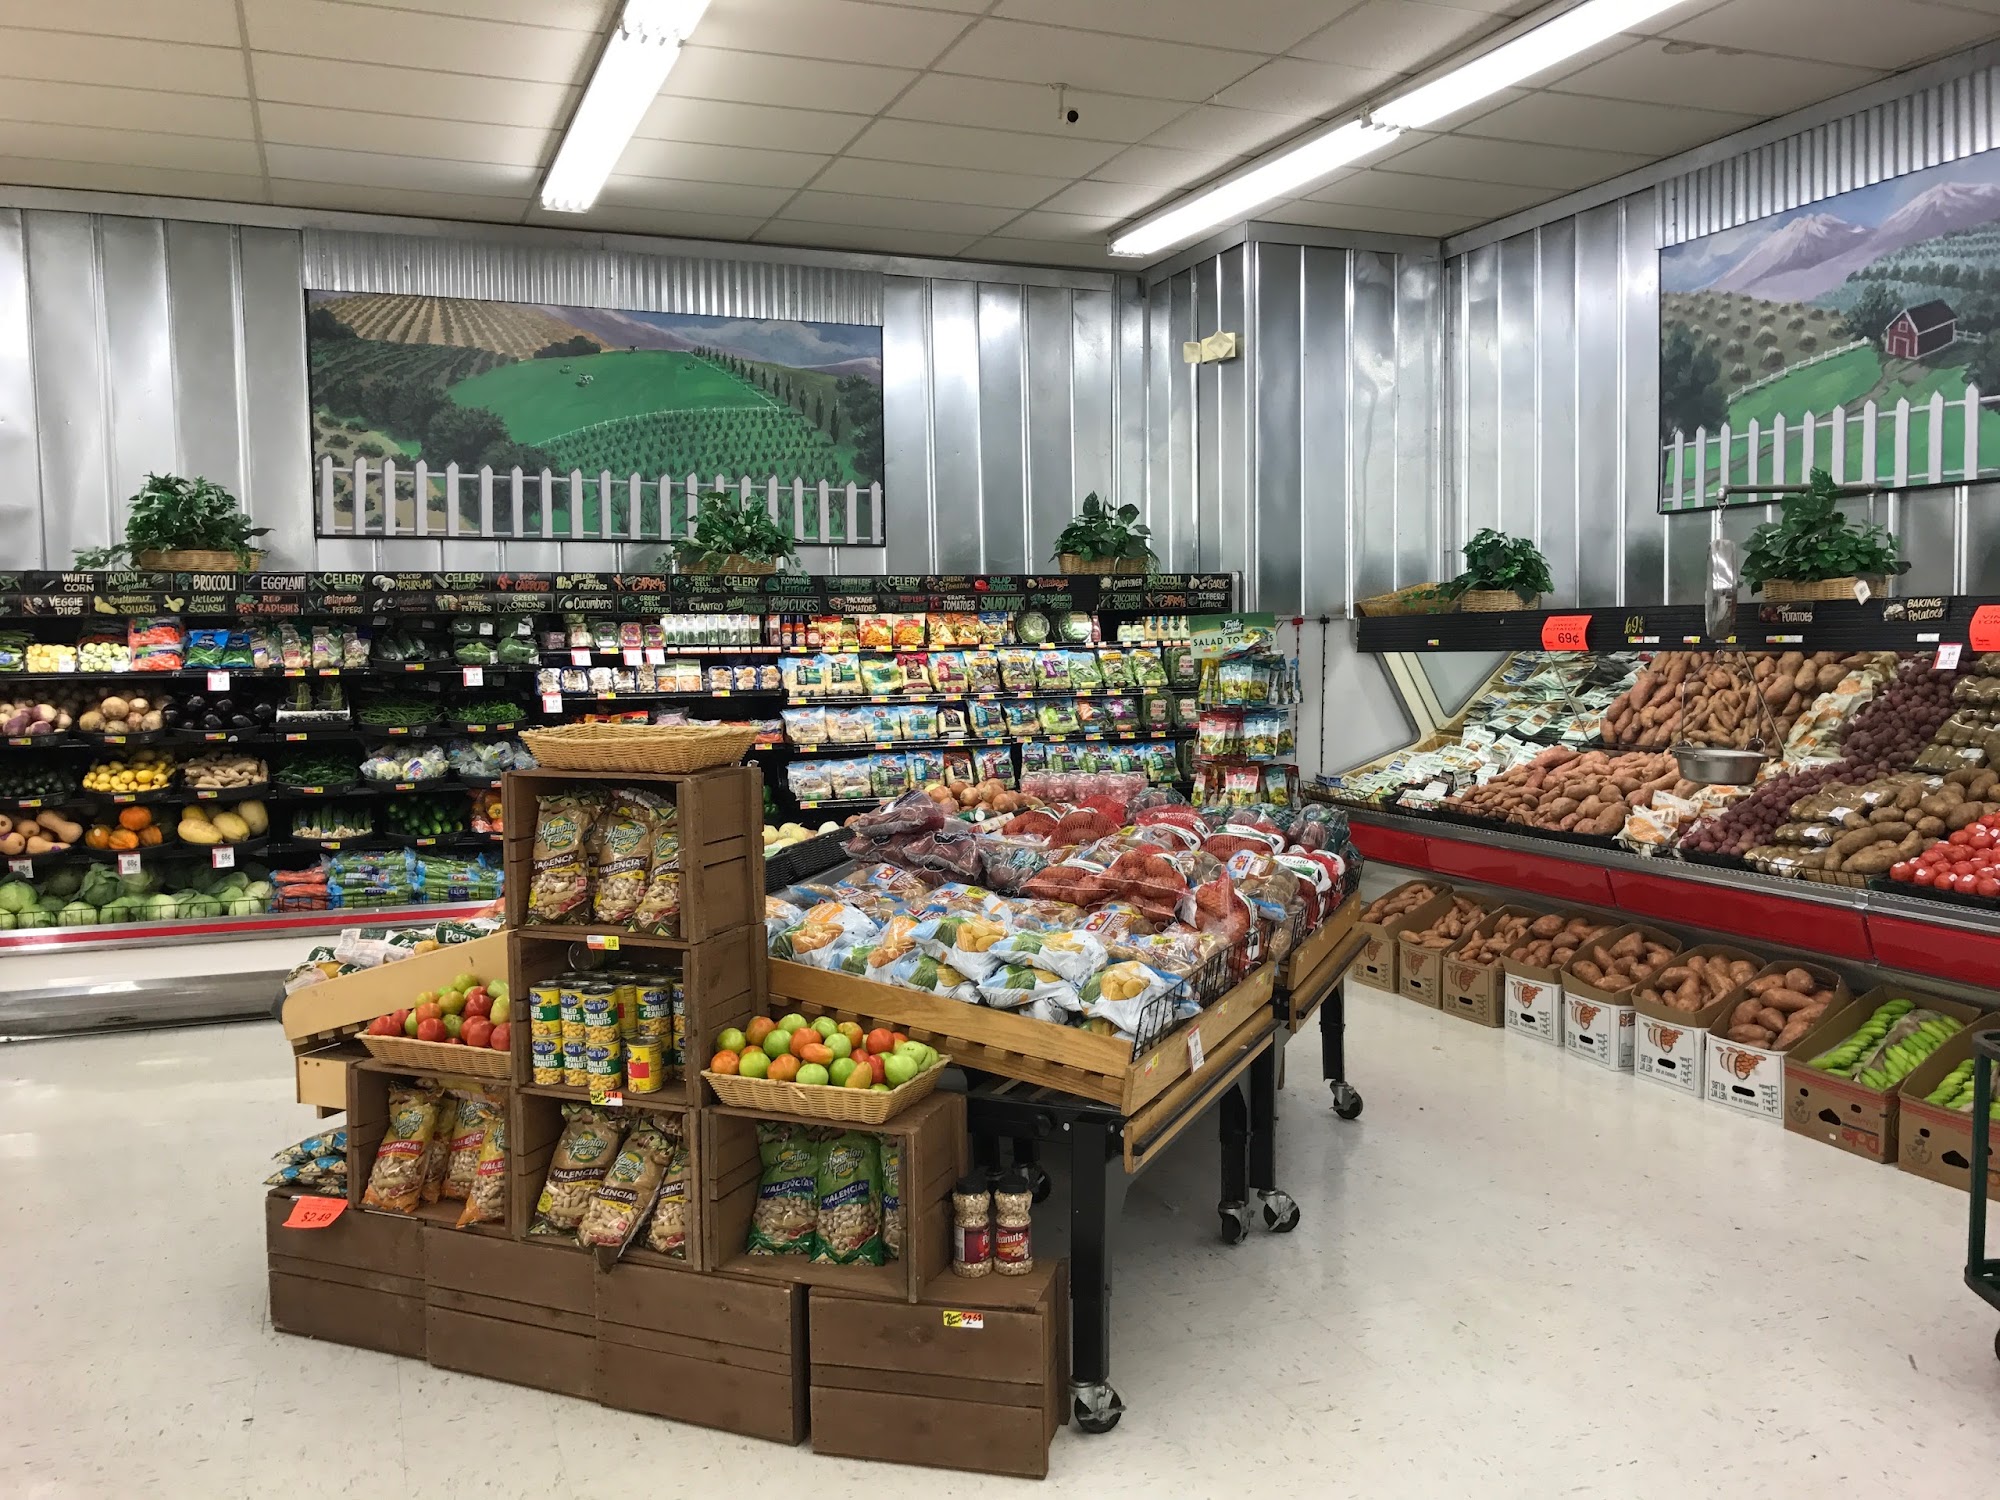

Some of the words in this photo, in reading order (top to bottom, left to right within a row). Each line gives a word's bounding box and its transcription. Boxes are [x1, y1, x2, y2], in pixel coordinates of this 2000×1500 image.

[62, 573, 93, 583] WHITE
[107, 572, 138, 586] ACORN
[193, 574, 236, 591] BROCCOLI
[261, 576, 306, 590] EGGPLANT
[323, 572, 365, 585] CELERY
[445, 573, 484, 583] CELERY
[724, 576, 760, 586] CELERY
[780, 577, 811, 585] ROMAINE
[888, 576, 921, 586] CELERY
[990, 576, 1012, 584] SALAD
[64, 583, 94, 592] CORN
[579, 583, 608, 591] PEPPERS
[632, 577, 667, 592] CARROTS
[1207, 579, 1229, 589] GARLIC
[780, 586, 815, 594] LETTUCE
[49, 595, 84, 606] VEGGIE
[846, 596, 873, 604] PACKAGE
[1112, 594, 1140, 602] ZUCCHINI
[1907, 598, 1941, 608] BAKING
[188, 603, 225, 613] SQUASH
[511, 601, 546, 609] ONIONS
[574, 597, 612, 610] Cucumbers
[688, 602, 724, 612] CILANTRO
[789, 599, 819, 611] CUKES
[844, 604, 877, 612] TOMATOES
[943, 600, 976, 611] TOMATOES
[981, 596, 1007, 611] SALAD
[1007, 597, 1025, 611] MIX
[1113, 602, 1140, 610] SQUASH
[54, 607, 81, 615] DIPS
[119, 604, 157, 614] SQUASH
[332, 606, 363, 614] PEPPERS
[1782, 612, 1813, 622] POTATOES
[1194, 637, 1224, 647] SALAD
[1558, 633, 1579, 645] 69¢
[604, 824, 647, 844] Hampton
[612, 836, 640, 853] Farms
[600, 860, 641, 874] VALENCIA
[586, 1012, 608, 1020] BOILED
[643, 1009, 669, 1017] PEANUTS
[823, 1149, 865, 1174] Hampton
[554, 1168, 599, 1177] VALENCIA
[834, 1158, 859, 1181] Farms
[764, 1178, 810, 1193] VALENCIA
[597, 1187, 637, 1200] ALENCIA
[824, 1184, 864, 1204] VALENCIA
